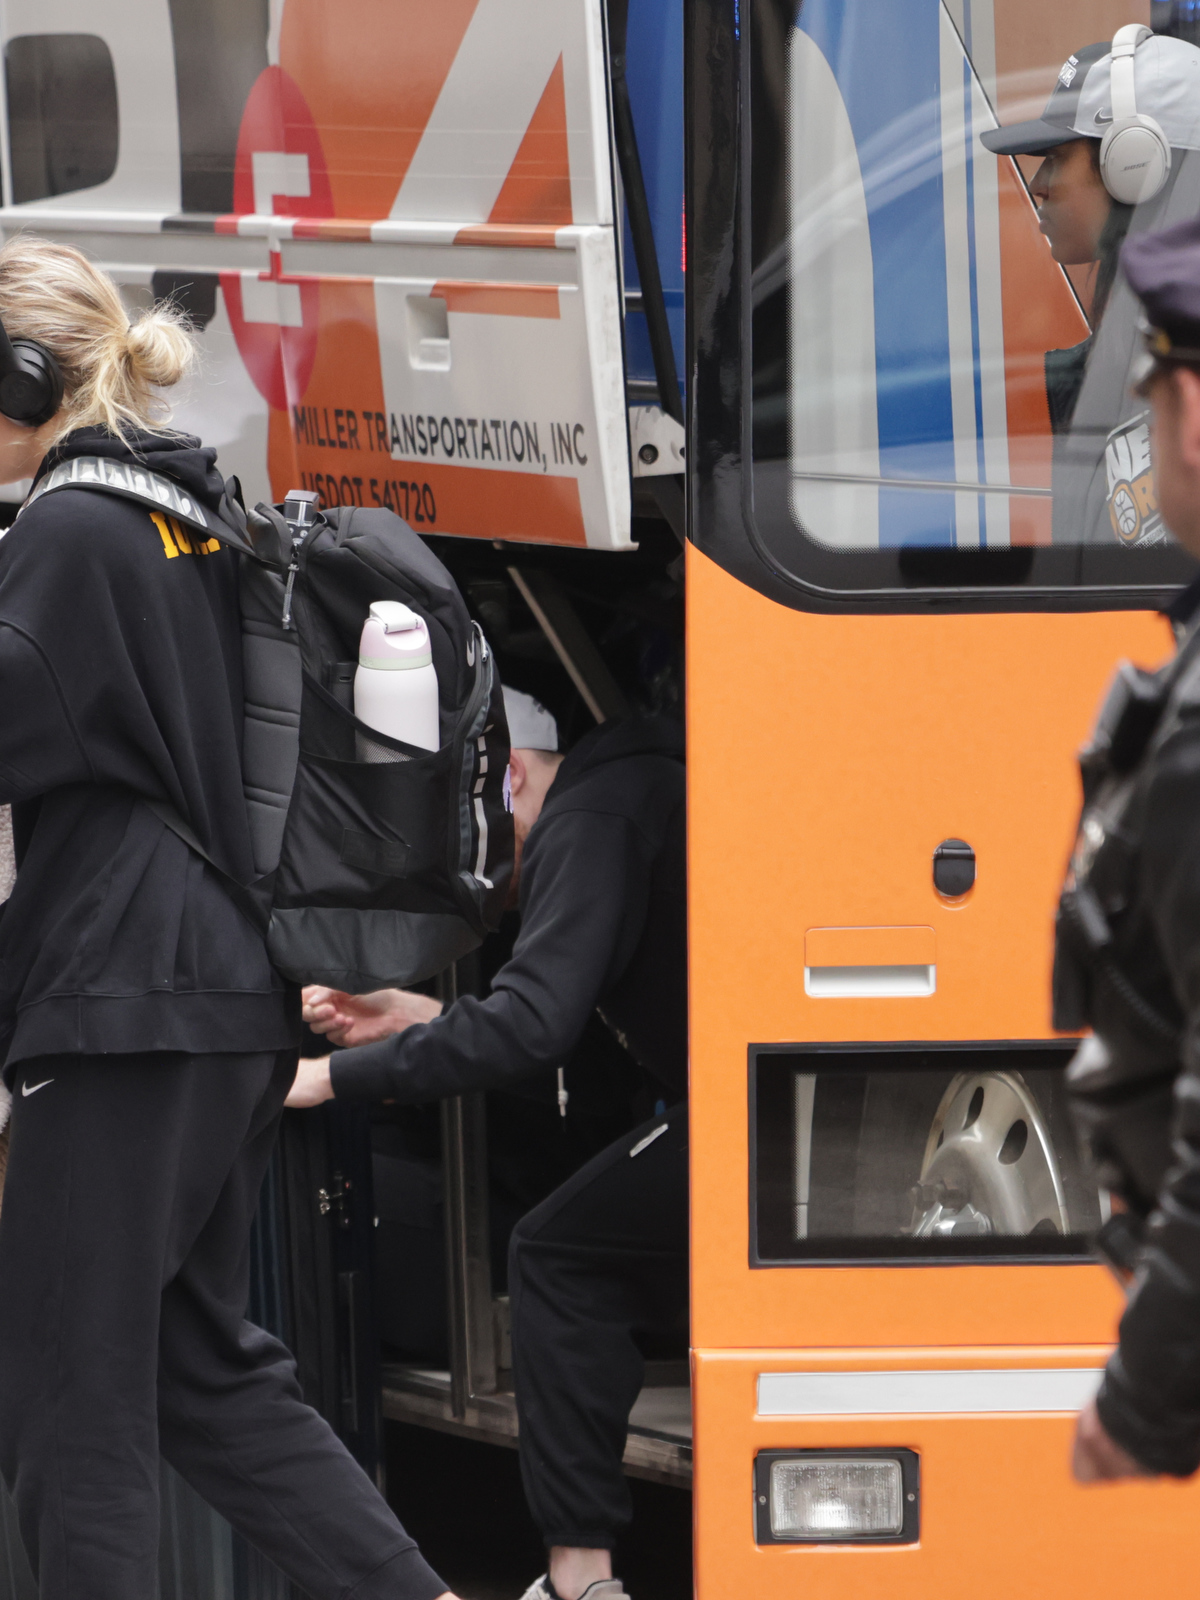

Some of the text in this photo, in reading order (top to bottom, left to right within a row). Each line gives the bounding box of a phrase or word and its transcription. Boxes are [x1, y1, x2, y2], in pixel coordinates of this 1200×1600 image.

[292, 405, 588, 472] MILLER TRANSPORTATION, INC
[369, 478, 437, 524] 541720
